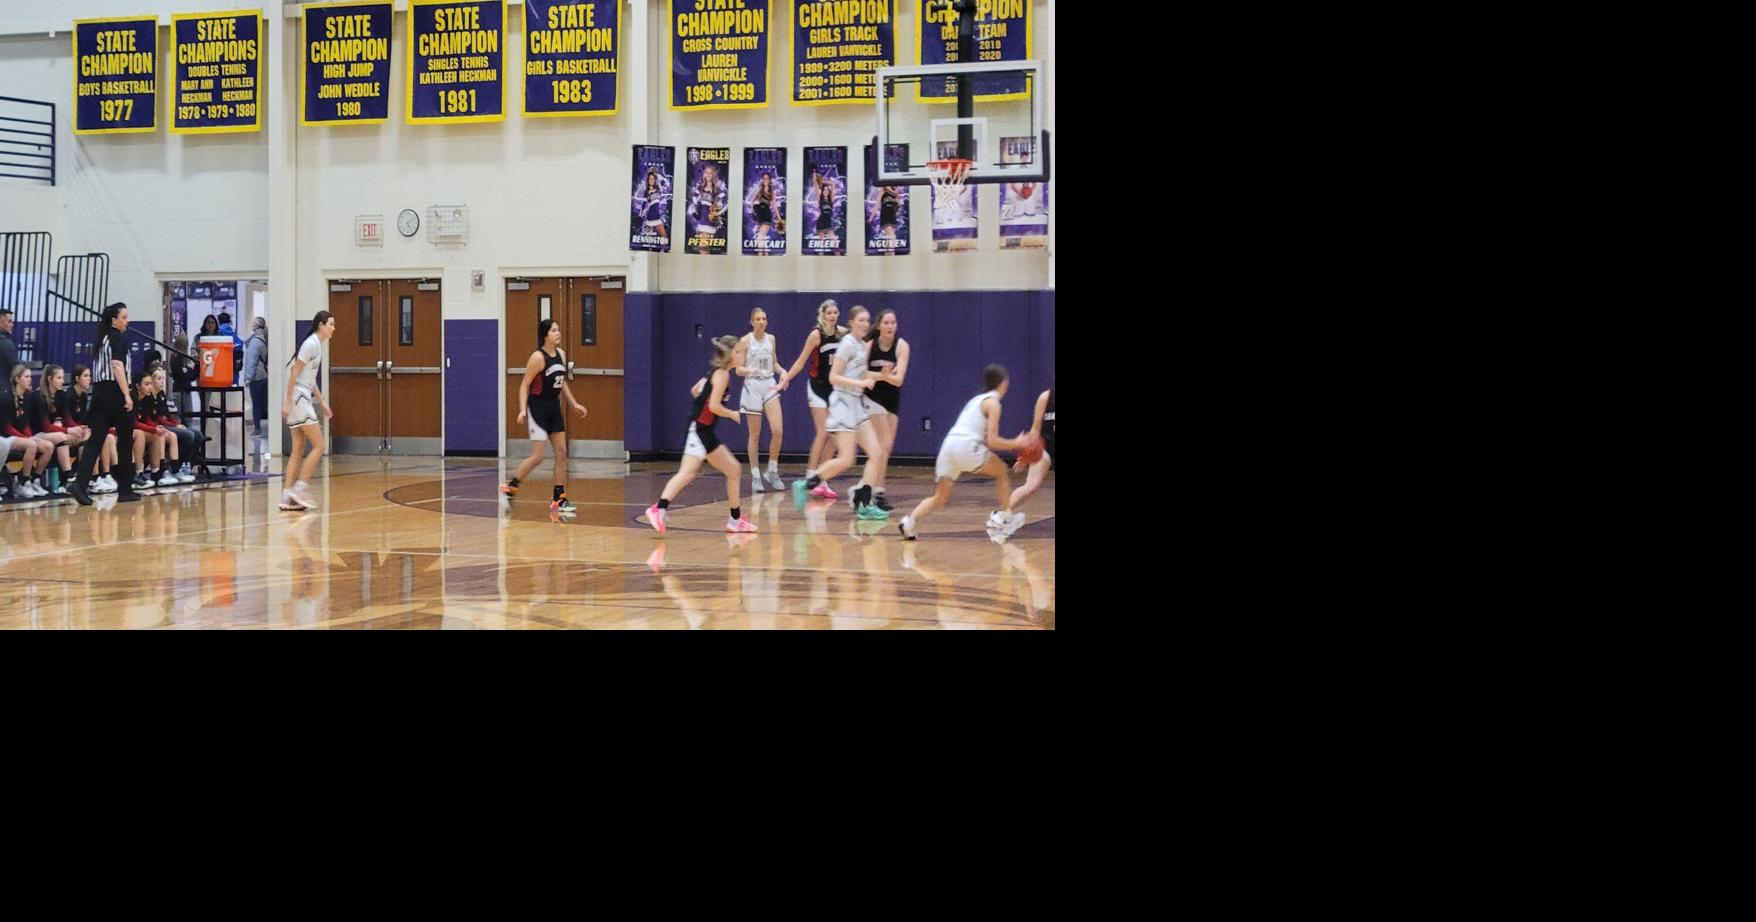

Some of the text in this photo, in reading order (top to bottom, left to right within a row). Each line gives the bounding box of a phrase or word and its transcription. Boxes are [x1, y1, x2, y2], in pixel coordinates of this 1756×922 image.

[434, 6, 480, 32] STATE
[548, 3, 595, 29] STATE
[798, 0, 889, 28] CHAMPION
[196, 18, 237, 41] STATE
[325, 14, 372, 39] STATE
[677, 9, 765, 37] CHAMPION
[979, 22, 1007, 40] TEAM
[96, 30, 136, 53] STATE
[419, 29, 498, 57] CHAMPION
[530, 27, 612, 54] CHAMPION
[809, 26, 879, 44] GIRLS TRACK
[178, 39, 257, 64] CHAMPIONS
[310, 37, 388, 64] CHAMPION
[682, 35, 759, 53] CROSS COUNTRY
[806, 44, 882, 59] LAUREN VANVICKLE
[979, 39, 1002, 50] 2019
[428, 55, 489, 71] SINGLES TENNIS
[701, 53, 739, 68] LAUREN
[979, 50, 1002, 61] 2020
[81, 52, 153, 77] CHAMPION
[188, 63, 247, 78] DOUBLES TENNIS
[323, 62, 375, 79] HIGH JUMP
[526, 57, 617, 76] GIRLS BASKETBALL
[221, 77, 254, 89] KATHLEEN
[420, 68, 497, 85] KATHLEEN HECKMAN
[697, 67, 747, 82] VANVICKLE
[79, 80, 155, 97] BOYS BASKETBALL
[181, 79, 214, 91] MARY ANN
[318, 82, 381, 99] JOHN WEDDLE
[551, 79, 592, 104] 1983
[181, 92, 213, 104] HECKMAN
[222, 90, 254, 102] HECKMAN
[438, 89, 477, 114] 1981
[99, 98, 134, 122] 1977
[336, 101, 361, 117] 1980
[700, 149, 730, 161] EAGLES
[362, 223, 377, 238] EXIT
[631, 234, 669, 246] BENNINGTON
[687, 237, 727, 247] PFISTER
[743, 239, 786, 249] CATHCART
[808, 239, 842, 249] EHLERT
[203, 350, 213, 365] G
